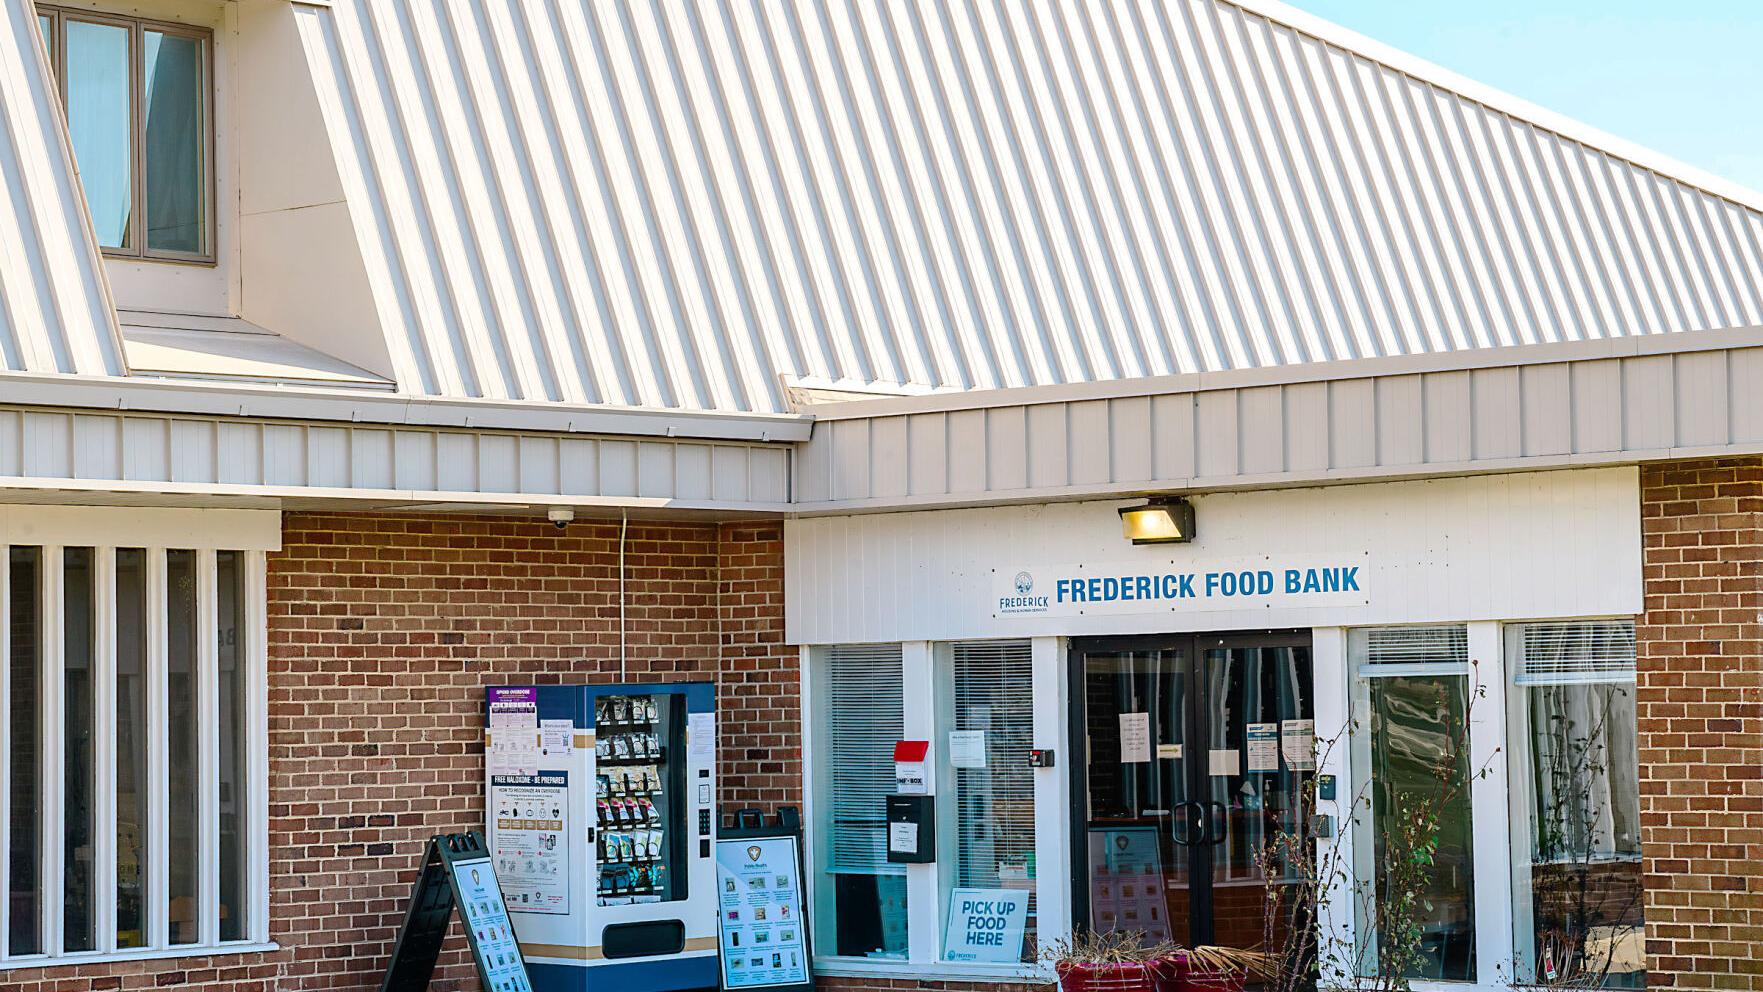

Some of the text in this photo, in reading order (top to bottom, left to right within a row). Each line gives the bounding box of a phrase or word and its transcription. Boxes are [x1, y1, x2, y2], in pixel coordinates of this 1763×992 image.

[1057, 566, 1361, 603] FREDERICK FOOD BANK
[1000, 596, 1049, 609] FREDERICK
[494, 775, 506, 783] FREE
[507, 776, 531, 784] NALOXONE
[534, 776, 540, 784] BE
[541, 776, 565, 785] PREPARED
[962, 900, 1016, 916] PICK UP
[968, 916, 1006, 930] FOOD
[966, 932, 1004, 946] HERE
